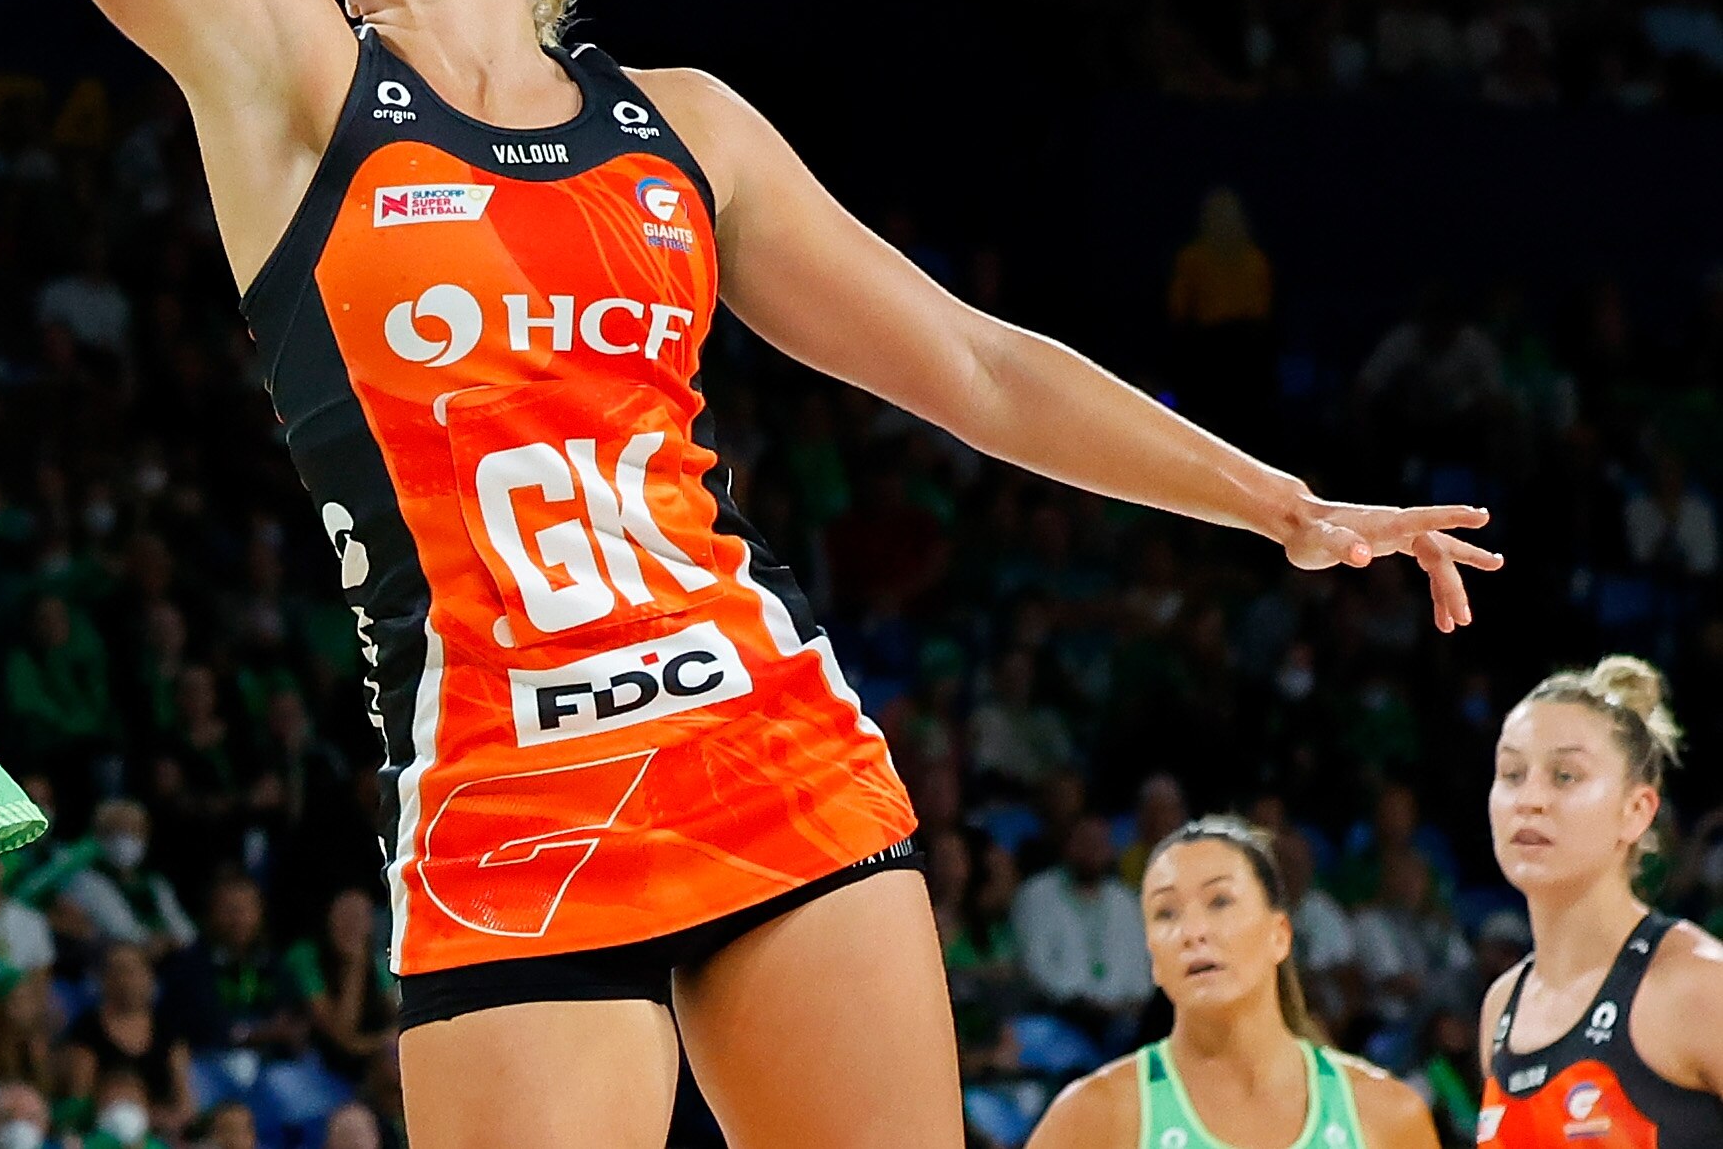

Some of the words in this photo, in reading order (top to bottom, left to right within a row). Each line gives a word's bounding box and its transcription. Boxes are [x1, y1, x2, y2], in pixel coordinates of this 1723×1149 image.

[373, 109, 416, 124] origin
[619, 125, 660, 140] origin
[492, 143, 569, 164] VALOUR
[412, 189, 465, 199] SUNCORP
[412, 198, 451, 208] SUPER
[412, 206, 467, 216] NETBALL
[643, 222, 693, 244] GIANTS
[501, 293, 694, 360] HCF
[475, 431, 718, 633] GK
[536, 650, 724, 730] FDC
